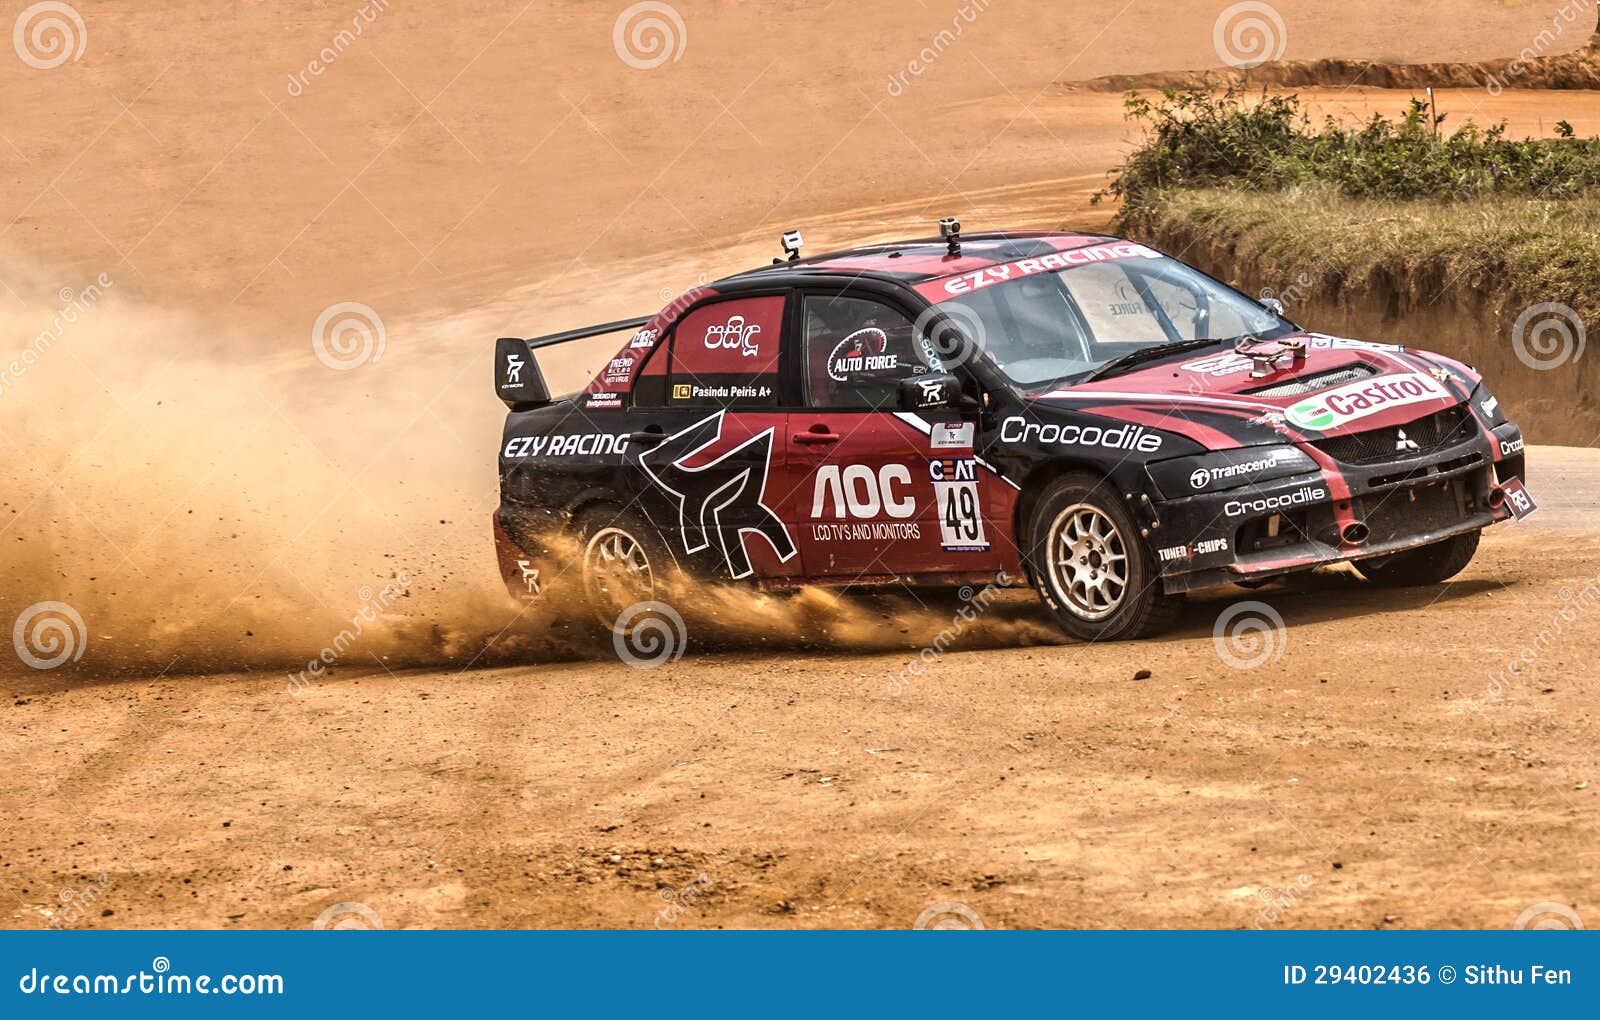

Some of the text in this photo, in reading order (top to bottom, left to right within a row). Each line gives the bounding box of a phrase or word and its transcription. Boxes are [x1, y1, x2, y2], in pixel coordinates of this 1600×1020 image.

[944, 244, 1140, 294] EZY RACING
[610, 357, 633, 368] TREND
[834, 354, 898, 373] AUTO FORCE
[913, 366, 929, 374] EZY
[692, 386, 772, 397] Pasindu Peiris A+
[1325, 376, 1437, 416] Castrol
[504, 433, 631, 458] EZY RACING
[1000, 416, 1163, 453] Crocodile
[929, 460, 977, 481] CEAT
[1210, 457, 1277, 480] Transcend
[810, 463, 916, 519] AOC
[1224, 487, 1326, 517] Crocodile
[945, 486, 979, 541] 49
[812, 523, 921, 541] LCD TV'S AND MONITORS
[1158, 545, 1187, 561] TUNED
